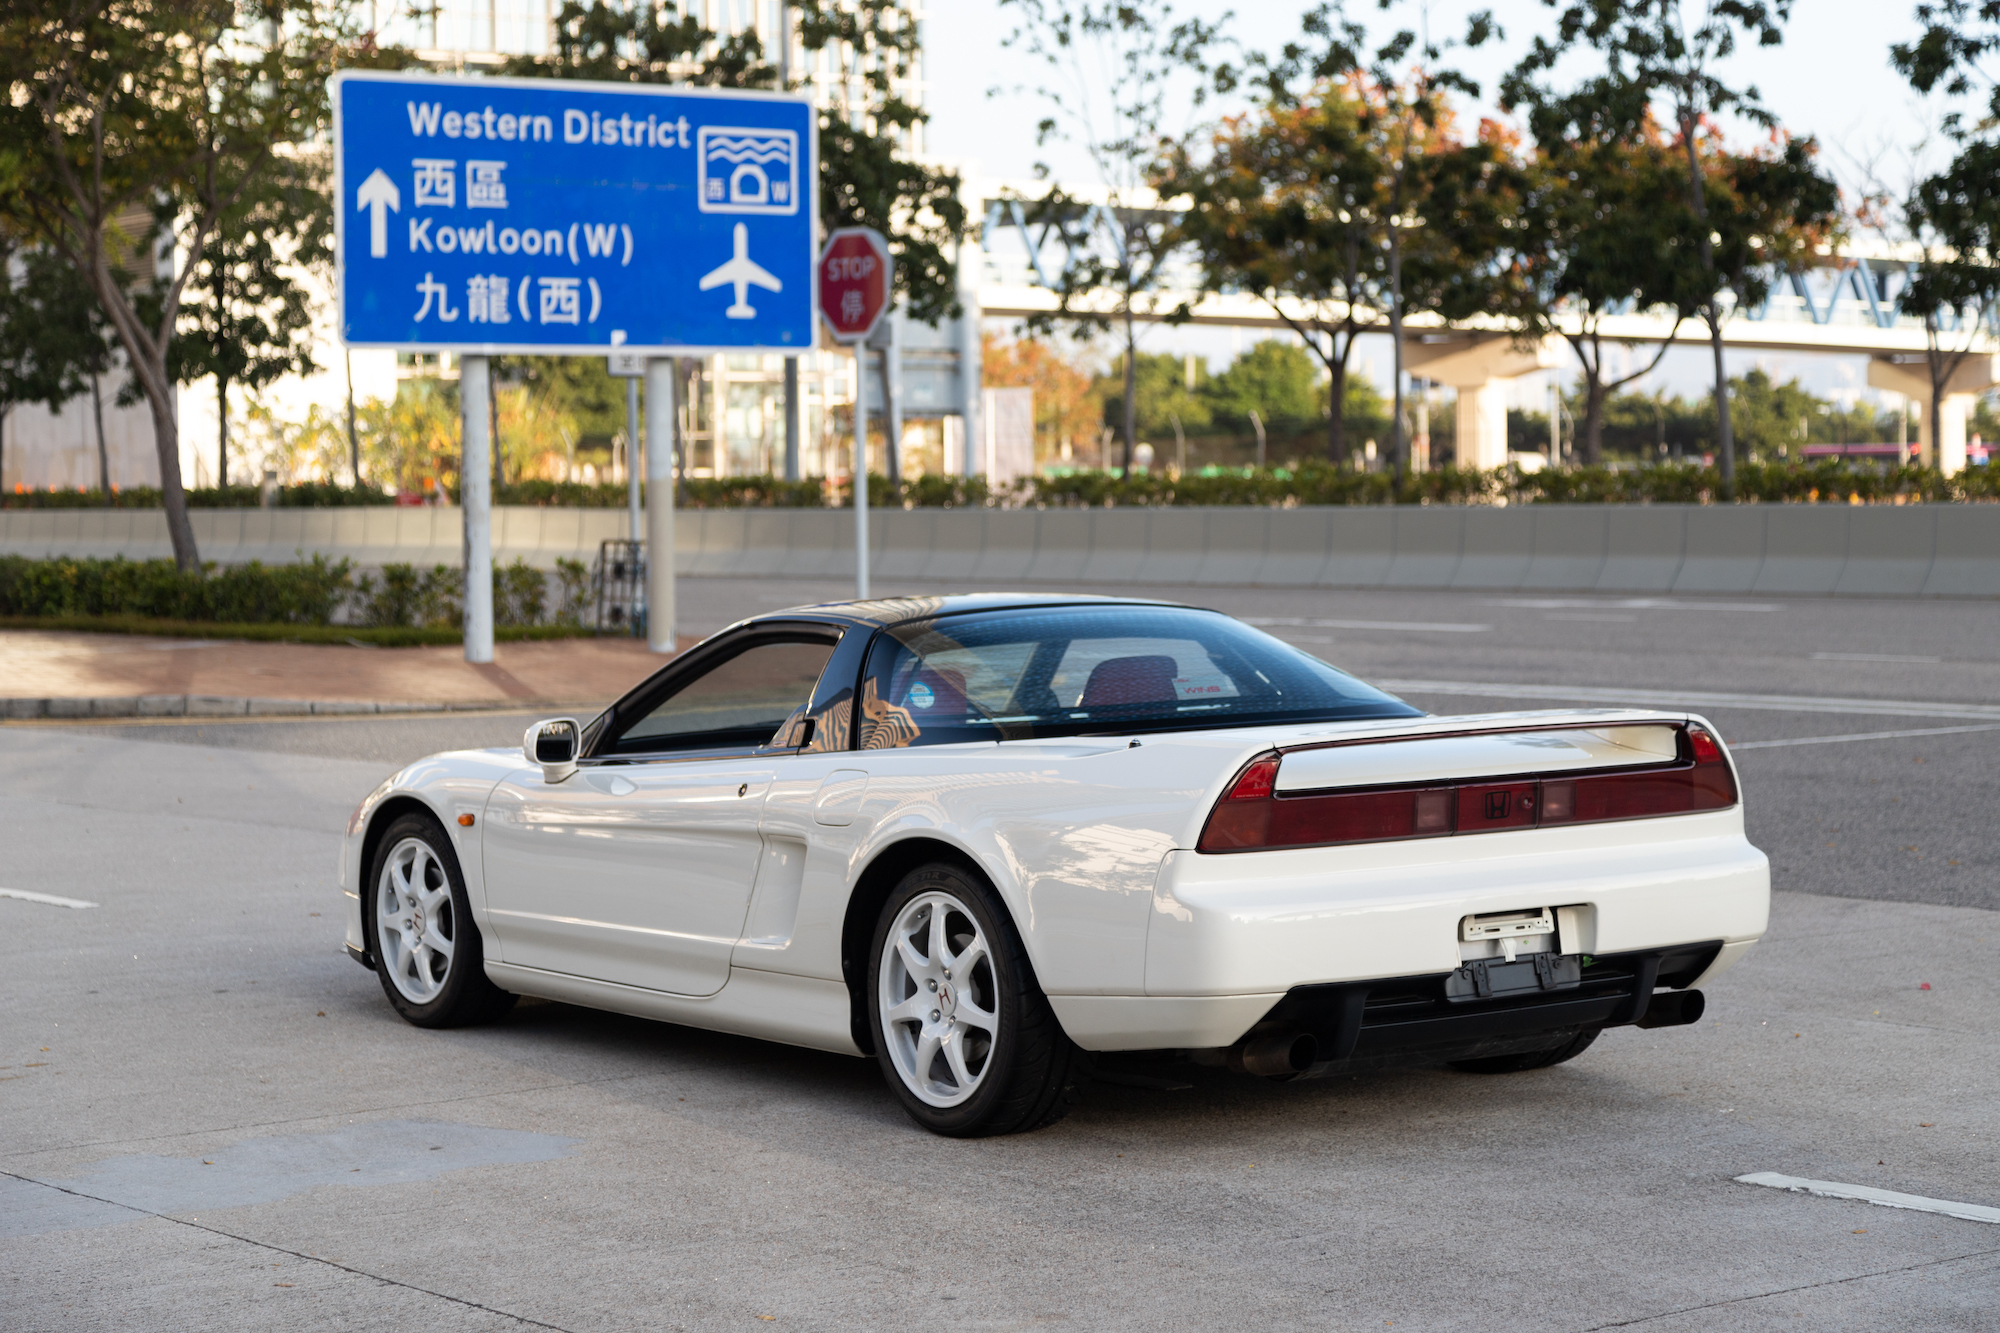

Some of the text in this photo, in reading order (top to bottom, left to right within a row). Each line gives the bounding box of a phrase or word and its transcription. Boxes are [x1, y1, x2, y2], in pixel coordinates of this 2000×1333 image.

[406, 100, 692, 149] Western District
[411, 158, 509, 209] 西區
[771, 180, 790, 203] W
[409, 217, 634, 267] Kowloon(W)
[828, 256, 876, 282] STOP
[841, 289, 866, 323] 停
